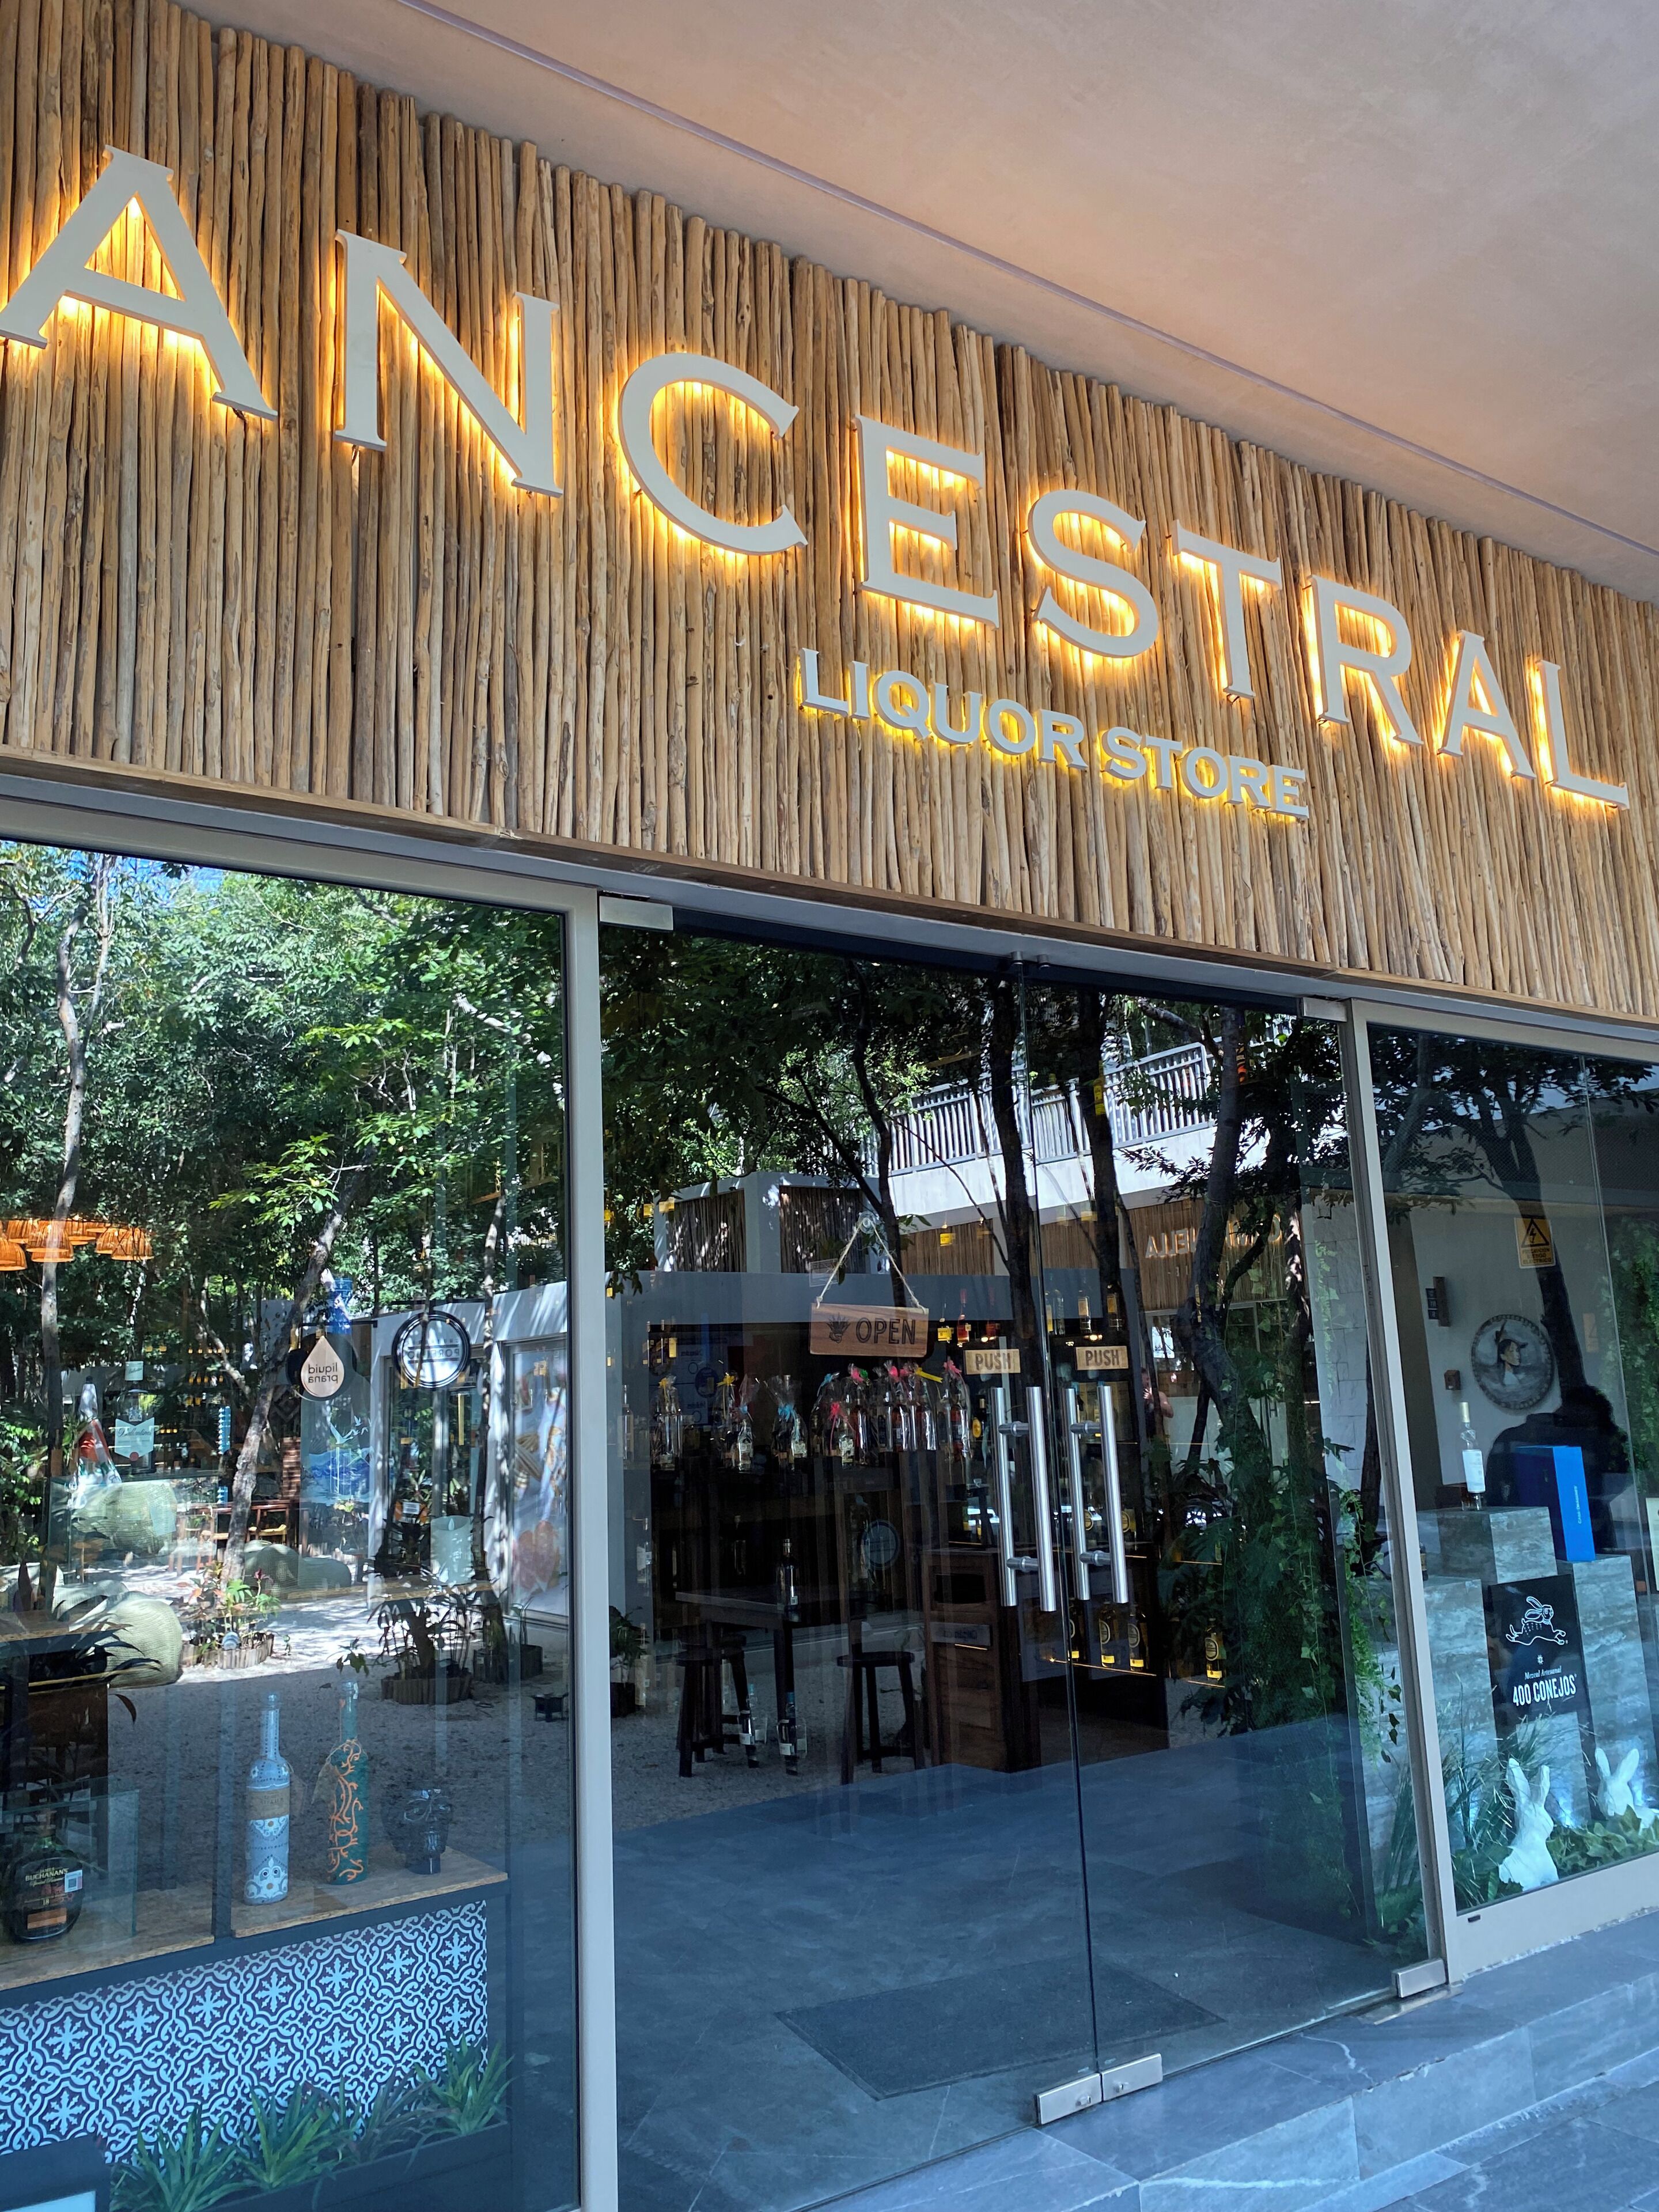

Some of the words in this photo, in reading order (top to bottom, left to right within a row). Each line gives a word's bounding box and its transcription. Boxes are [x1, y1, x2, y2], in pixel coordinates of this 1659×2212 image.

[0, 145, 1630, 810] ANCESTRAL
[801, 647, 1088, 770] LIQUOR
[1100, 726, 1309, 819] STORE
[856, 1317, 916, 1344] OPEN
[975, 1353, 1011, 1370] PUSH
[1085, 1350, 1120, 1366] PUSH
[1513, 1683, 1532, 1706] 400
